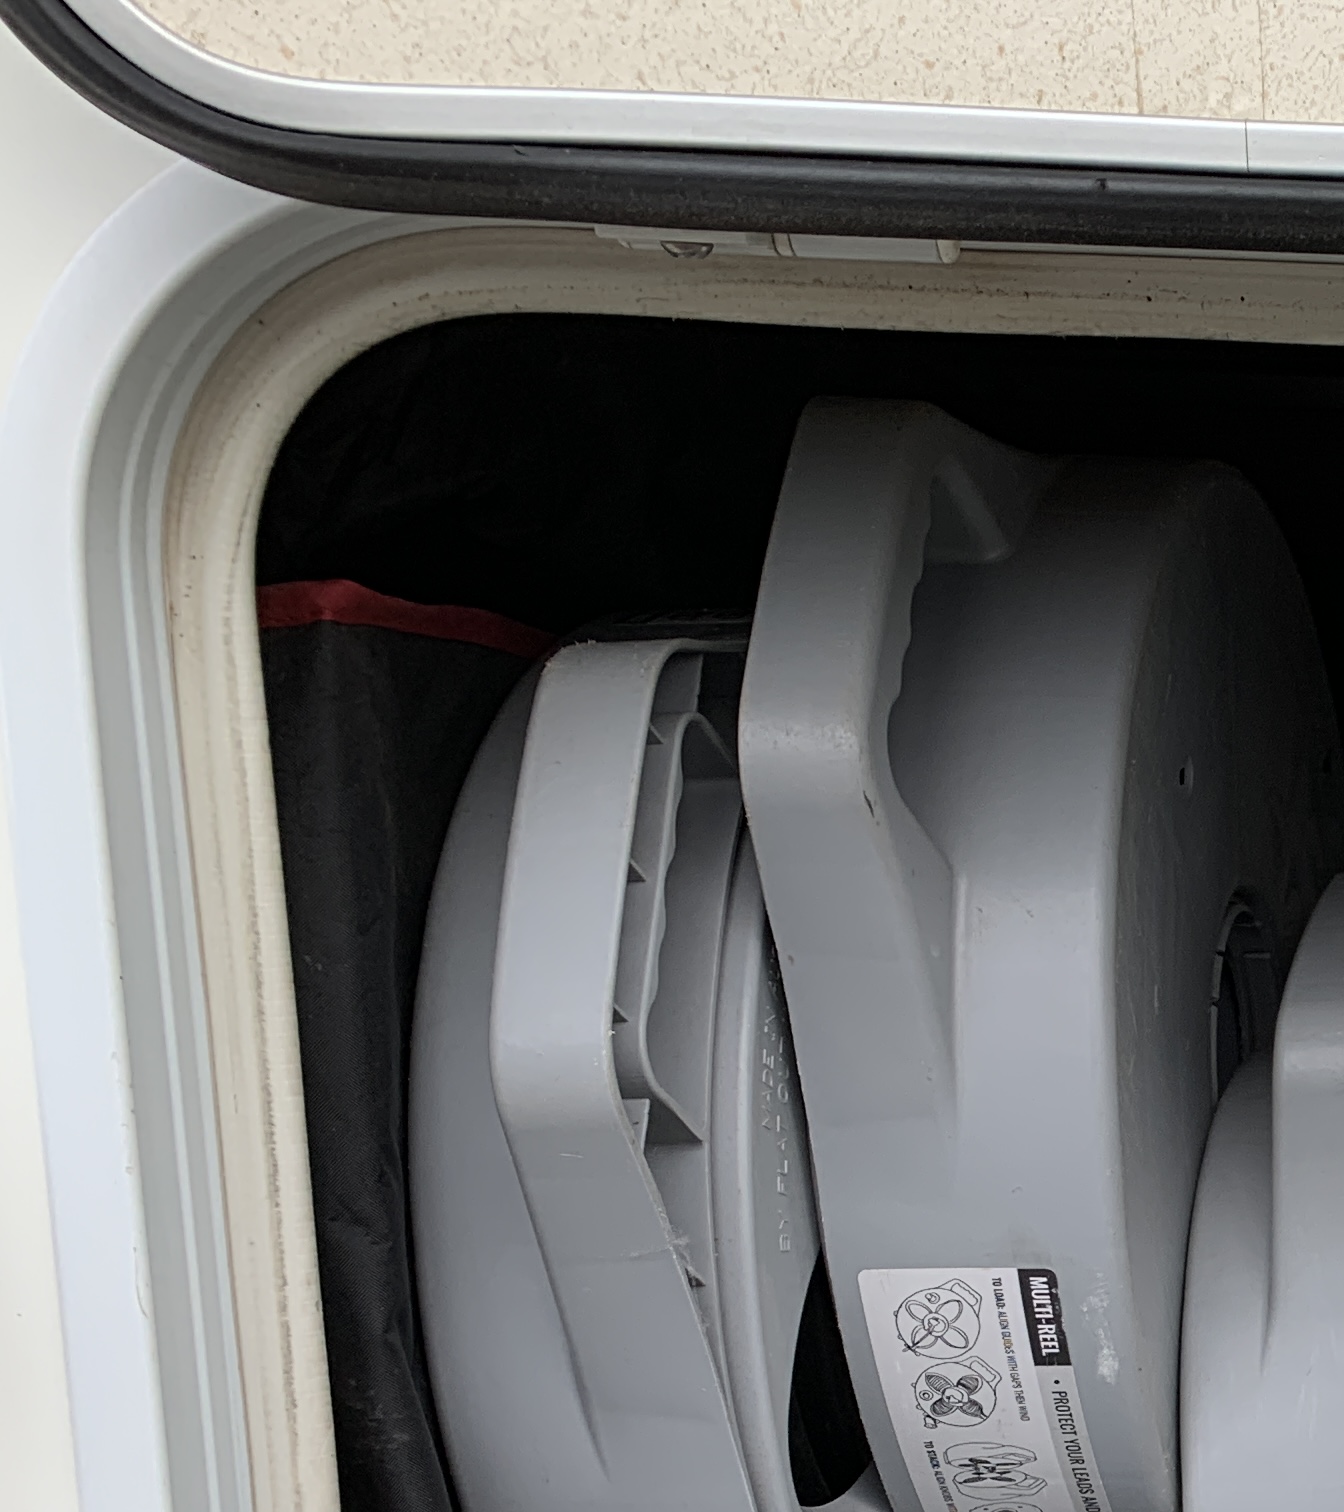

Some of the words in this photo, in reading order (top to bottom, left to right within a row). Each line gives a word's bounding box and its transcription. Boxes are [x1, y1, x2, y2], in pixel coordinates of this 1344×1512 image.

[991, 1277, 1002, 1287] TO
[997, 1310, 1011, 1330] ALIGN
[1029, 1276, 1060, 1357] MULTI-REEL
[1052, 1390, 1078, 1436] PROTECT
[1064, 1438, 1085, 1465] YOUR
[1072, 1467, 1095, 1495] LEADS
[1081, 1496, 1101, 1512] AND
